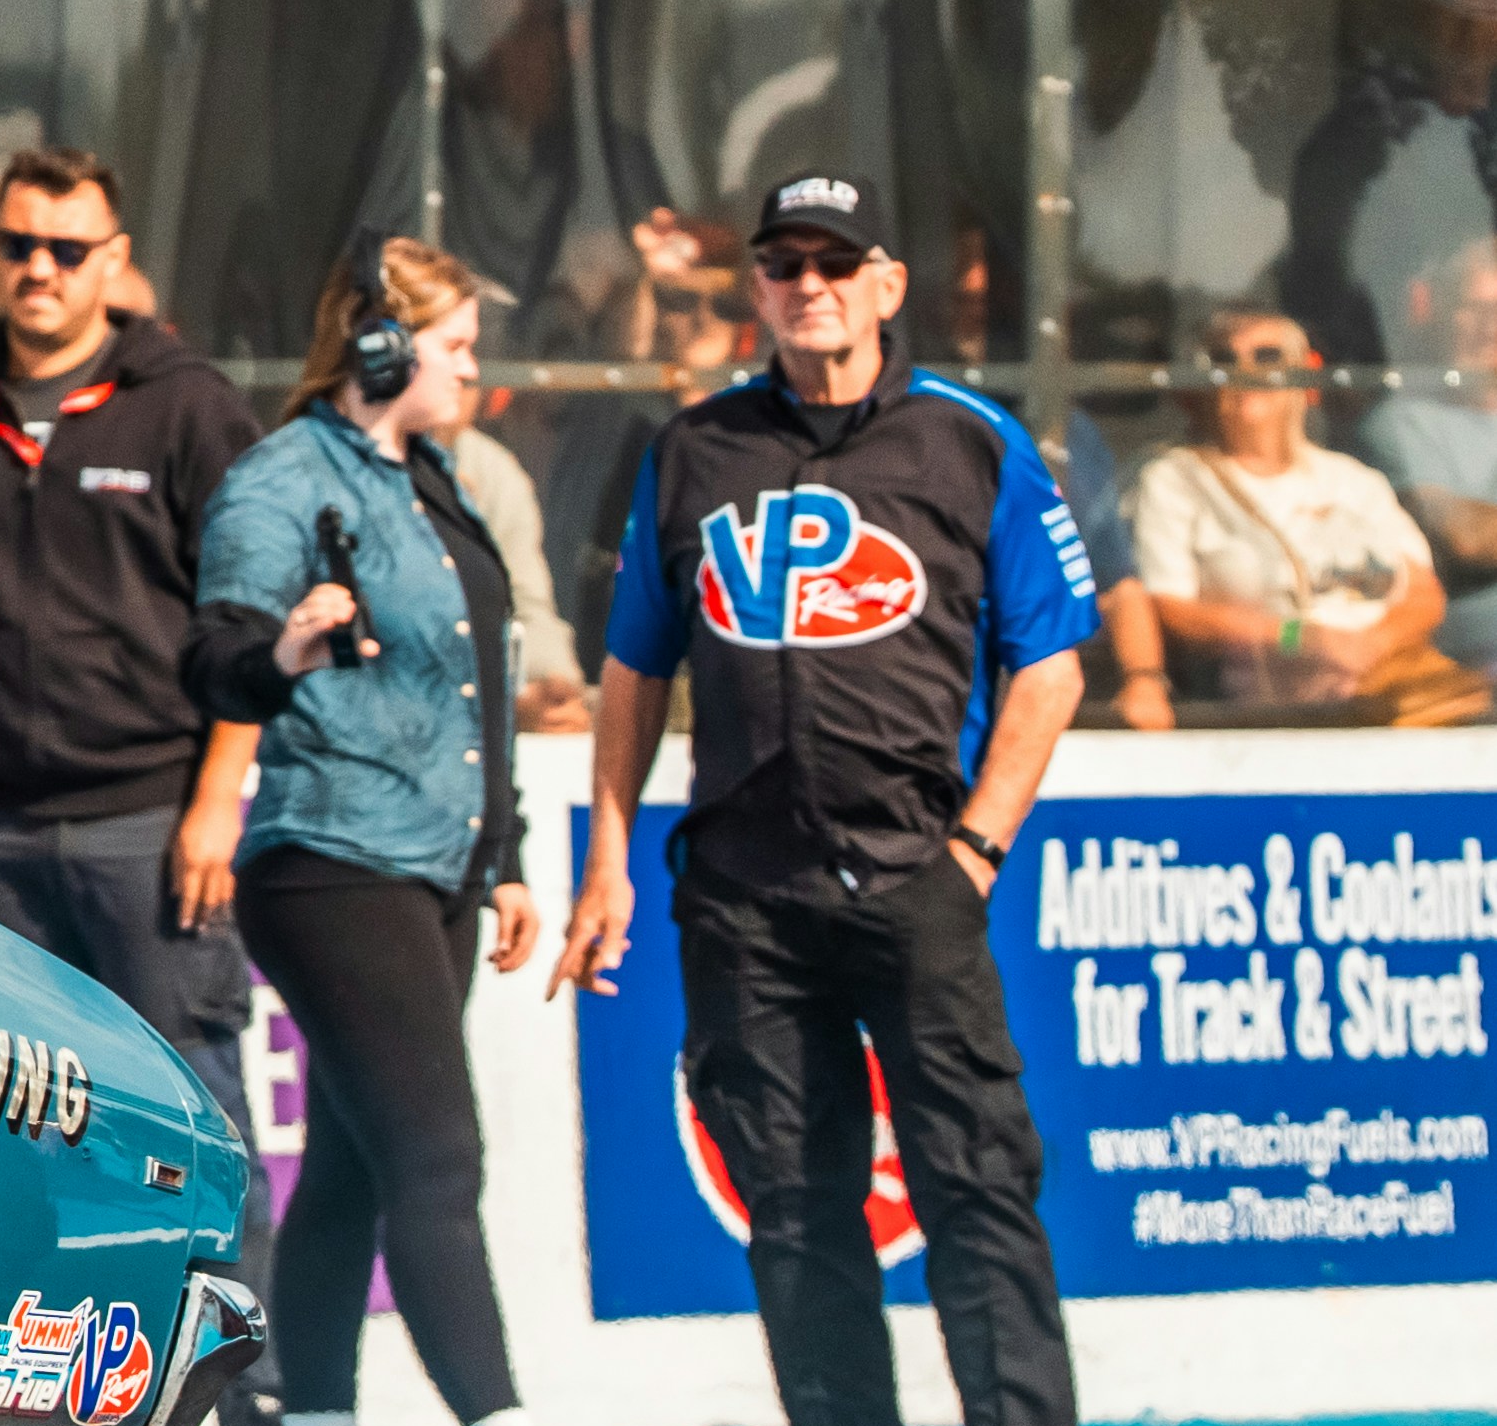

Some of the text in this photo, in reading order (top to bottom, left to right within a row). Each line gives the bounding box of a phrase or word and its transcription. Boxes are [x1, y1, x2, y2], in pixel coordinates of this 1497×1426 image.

[700, 484, 850, 647] VP
[798, 575, 914, 626] Racing
[1038, 837, 1258, 950] Additives
[1264, 834, 1303, 946] &
[1073, 945, 1488, 1066] for Track & Street
[1132, 1179, 1456, 1248] #MoreThanRaceFuel
[14, 1296, 88, 1351] SUMMIT
[78, 1306, 136, 1424] VP
